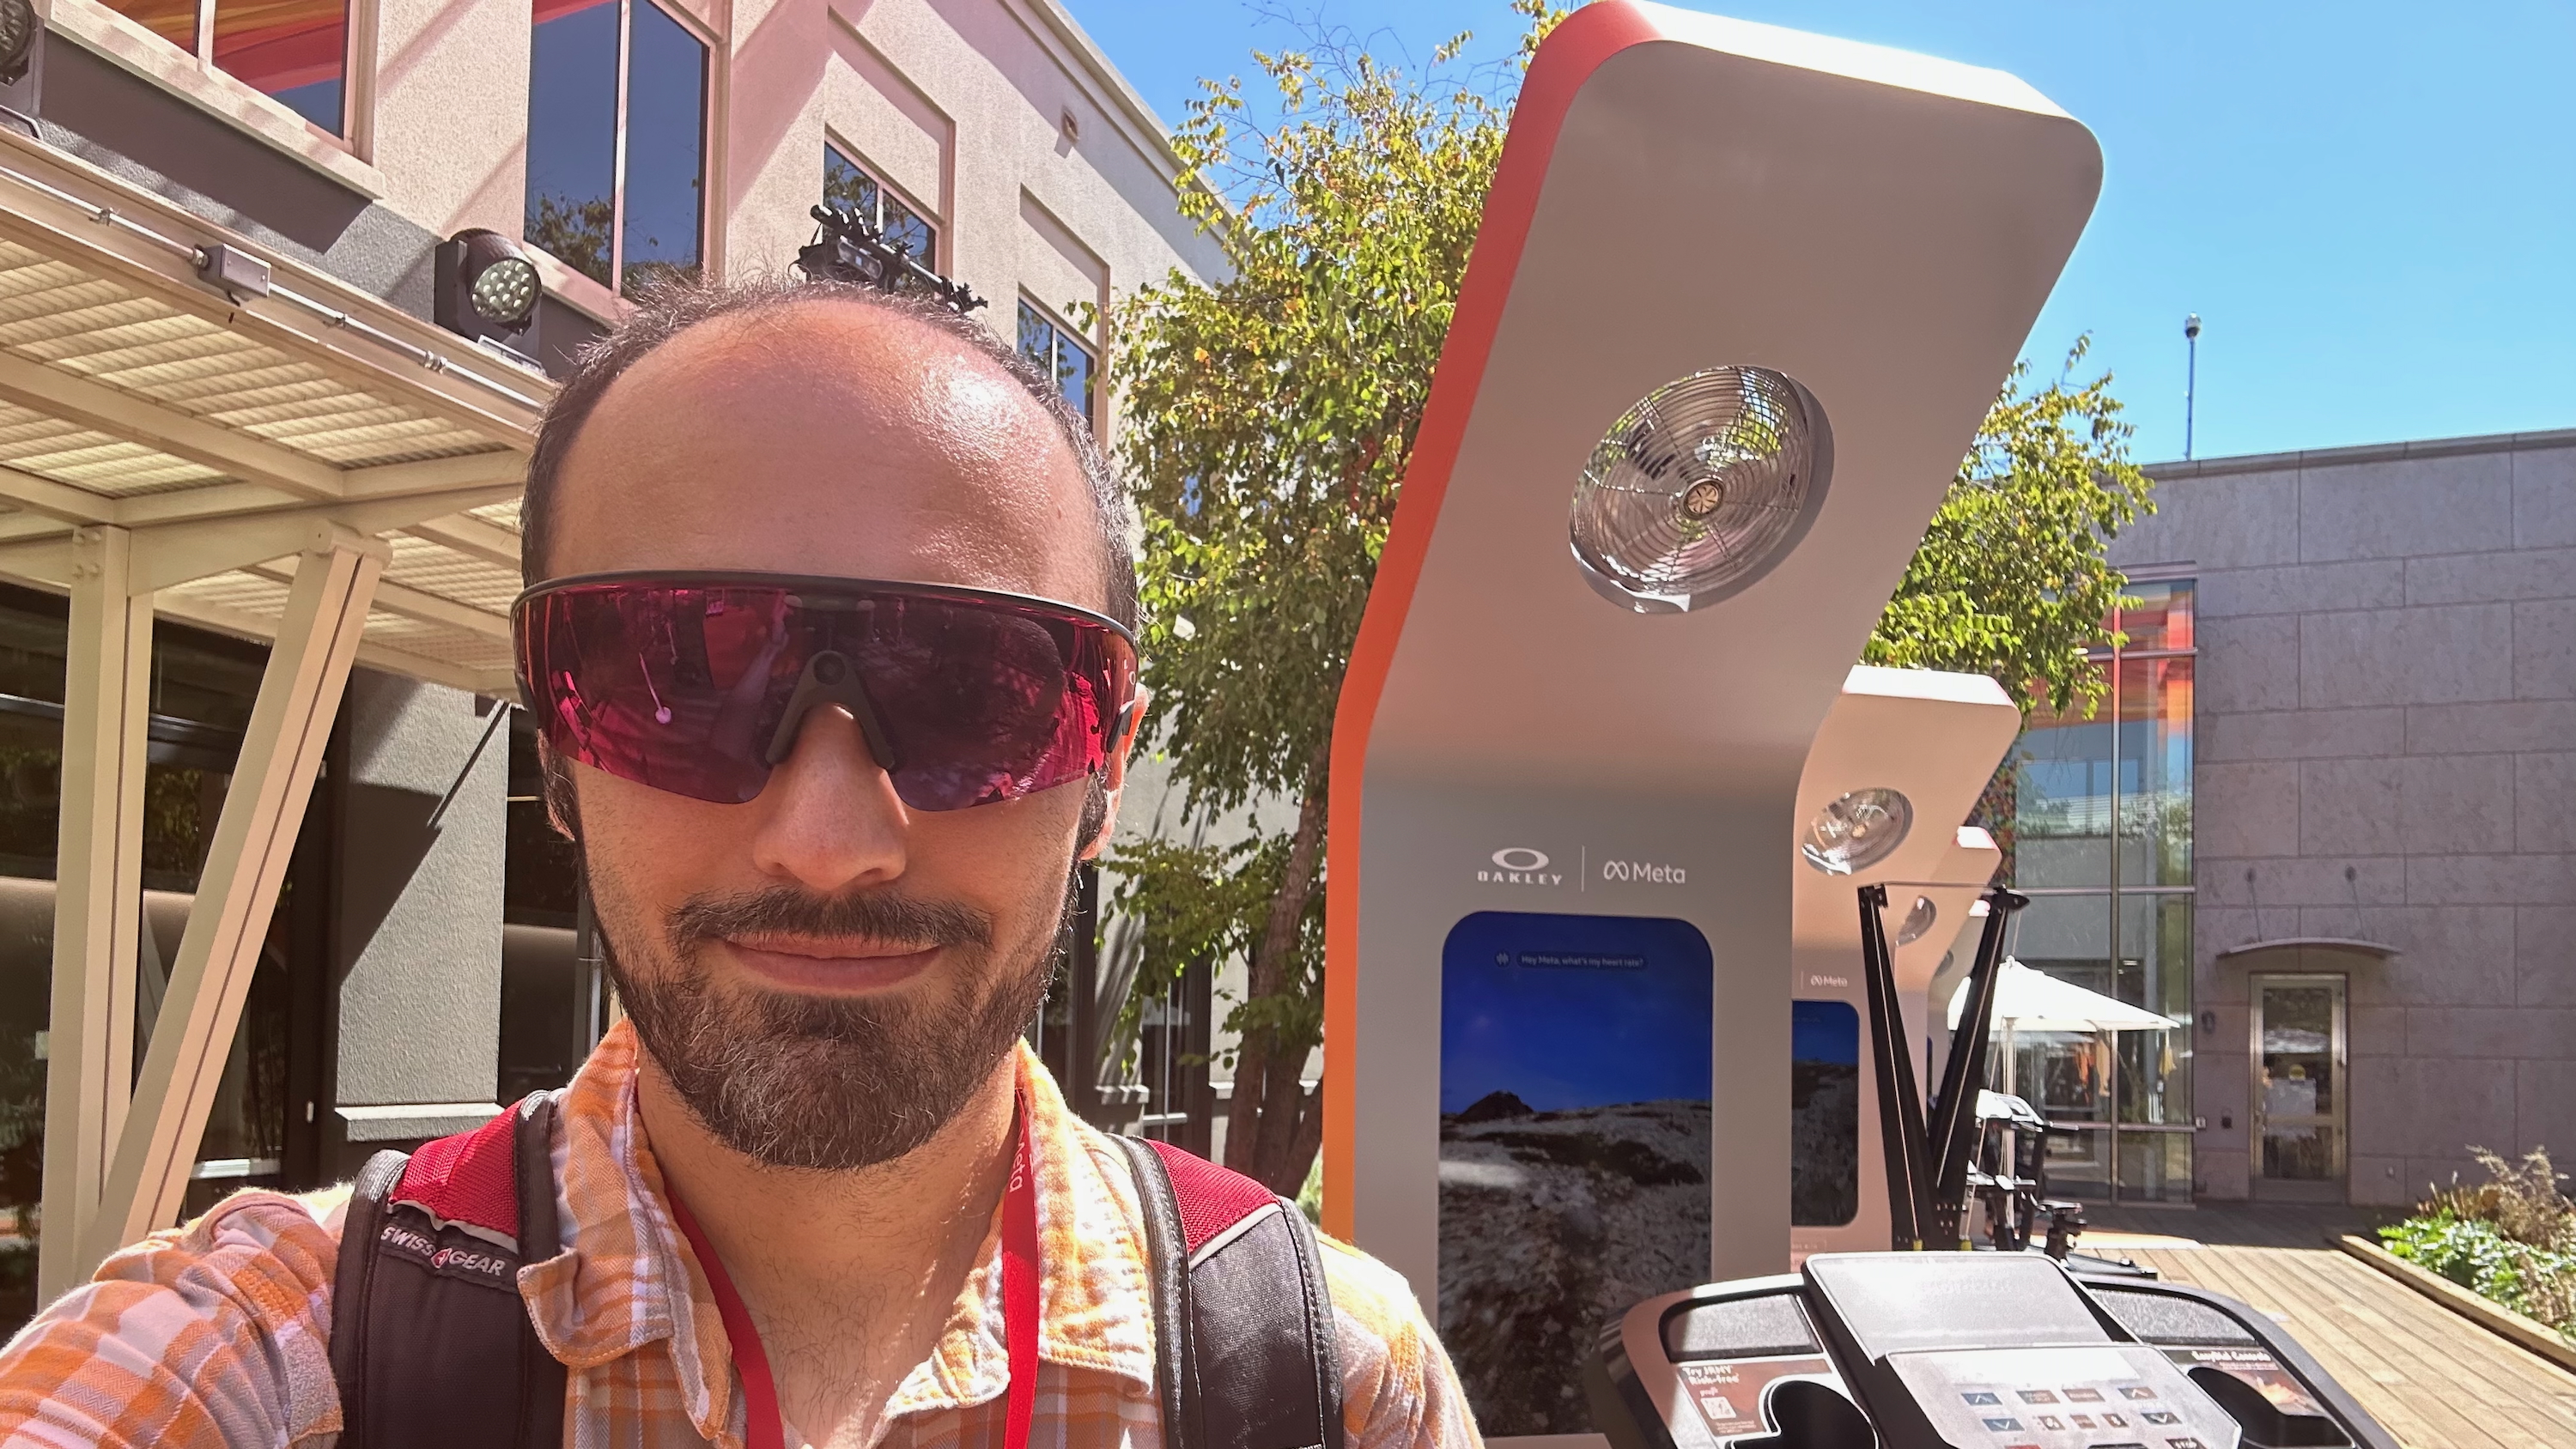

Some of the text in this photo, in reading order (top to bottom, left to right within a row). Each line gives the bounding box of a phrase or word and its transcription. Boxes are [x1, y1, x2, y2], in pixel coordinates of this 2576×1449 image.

[1477, 870, 1563, 886] OAKLEY
[1632, 862, 1686, 884] Meta
[1522, 955, 1538, 966] Hey
[1589, 958, 1601, 967] my
[1602, 957, 1622, 967] heart
[1823, 975, 1848, 987] Meta
[380, 1226, 507, 1276] SWISS GEAR
